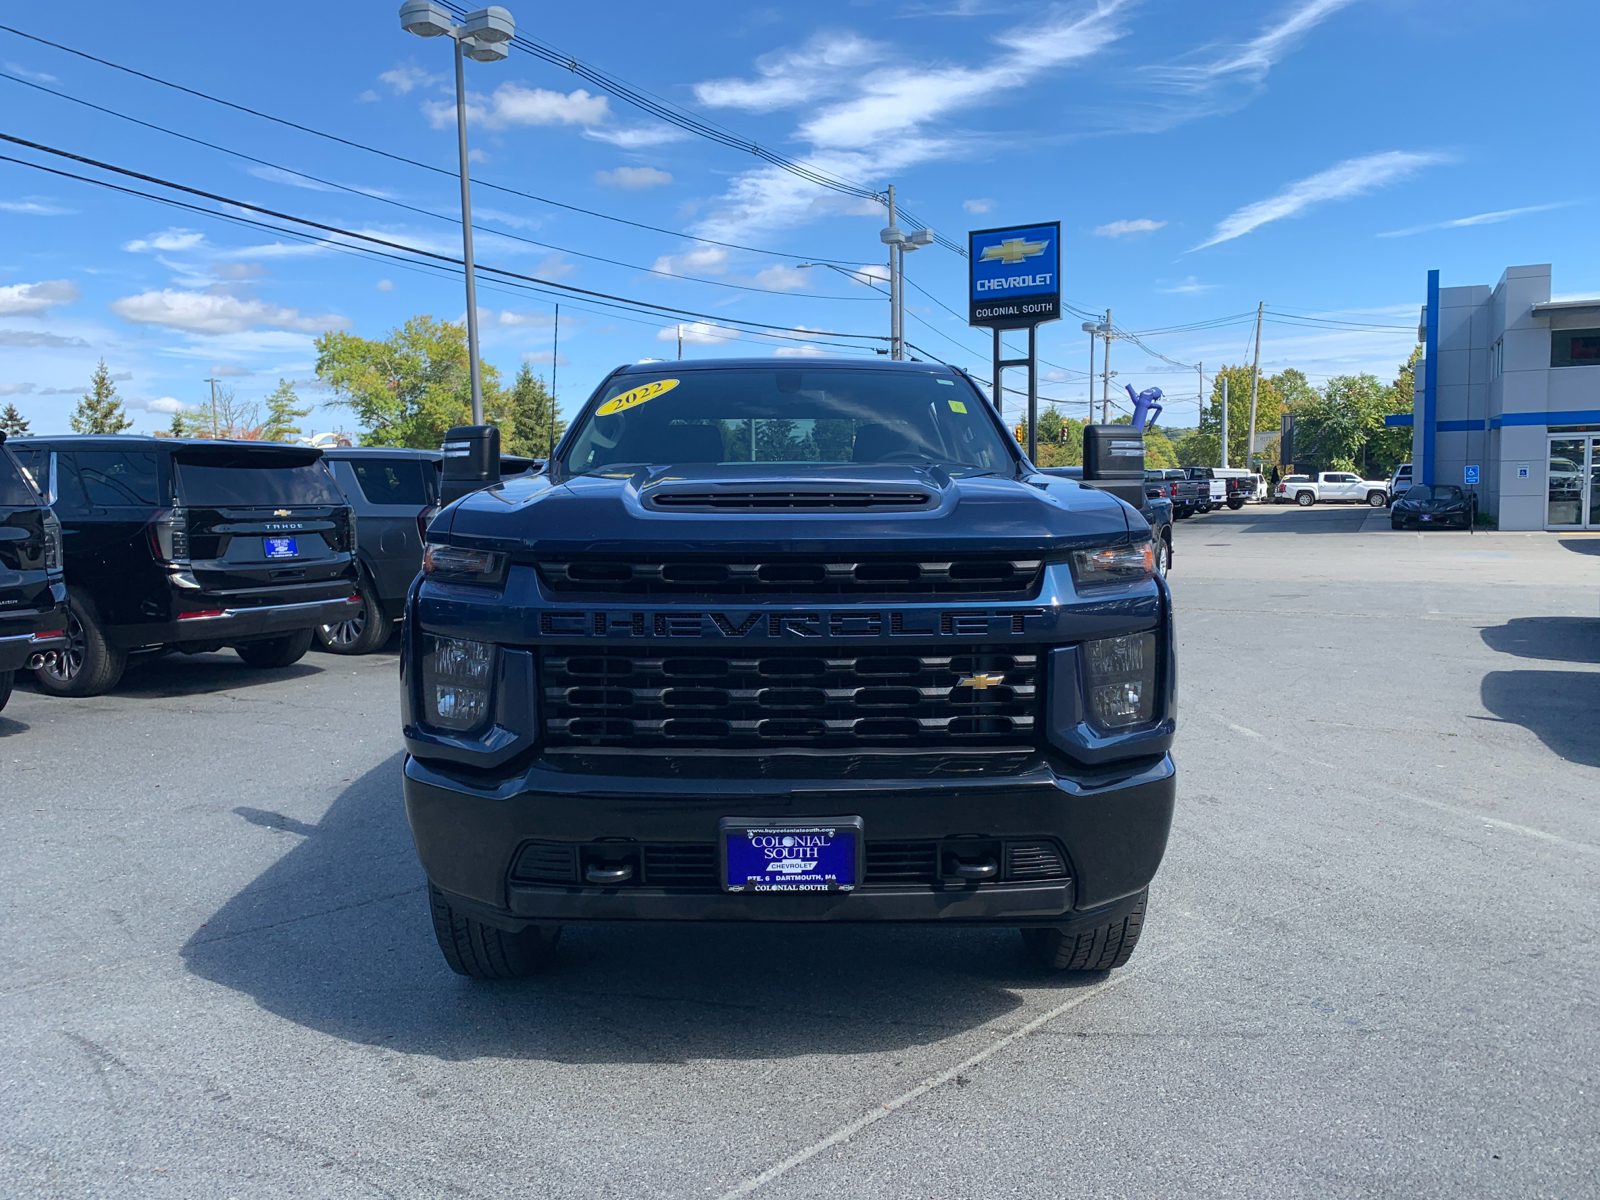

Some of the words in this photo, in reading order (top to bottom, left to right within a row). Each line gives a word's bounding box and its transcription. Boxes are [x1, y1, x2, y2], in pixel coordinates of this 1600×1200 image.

[976, 273, 1053, 292] CHEVROLET
[976, 306, 1019, 318] COLONIAL
[1022, 303, 1053, 314] SOUTH
[612, 382, 664, 411] 2022
[540, 608, 1044, 638] CHEVROLET
[751, 835, 831, 848] COLONIAL
[764, 847, 818, 859] SOUTH
[771, 862, 813, 870] CHEVROLET
[754, 884, 798, 892] COLONIAL
